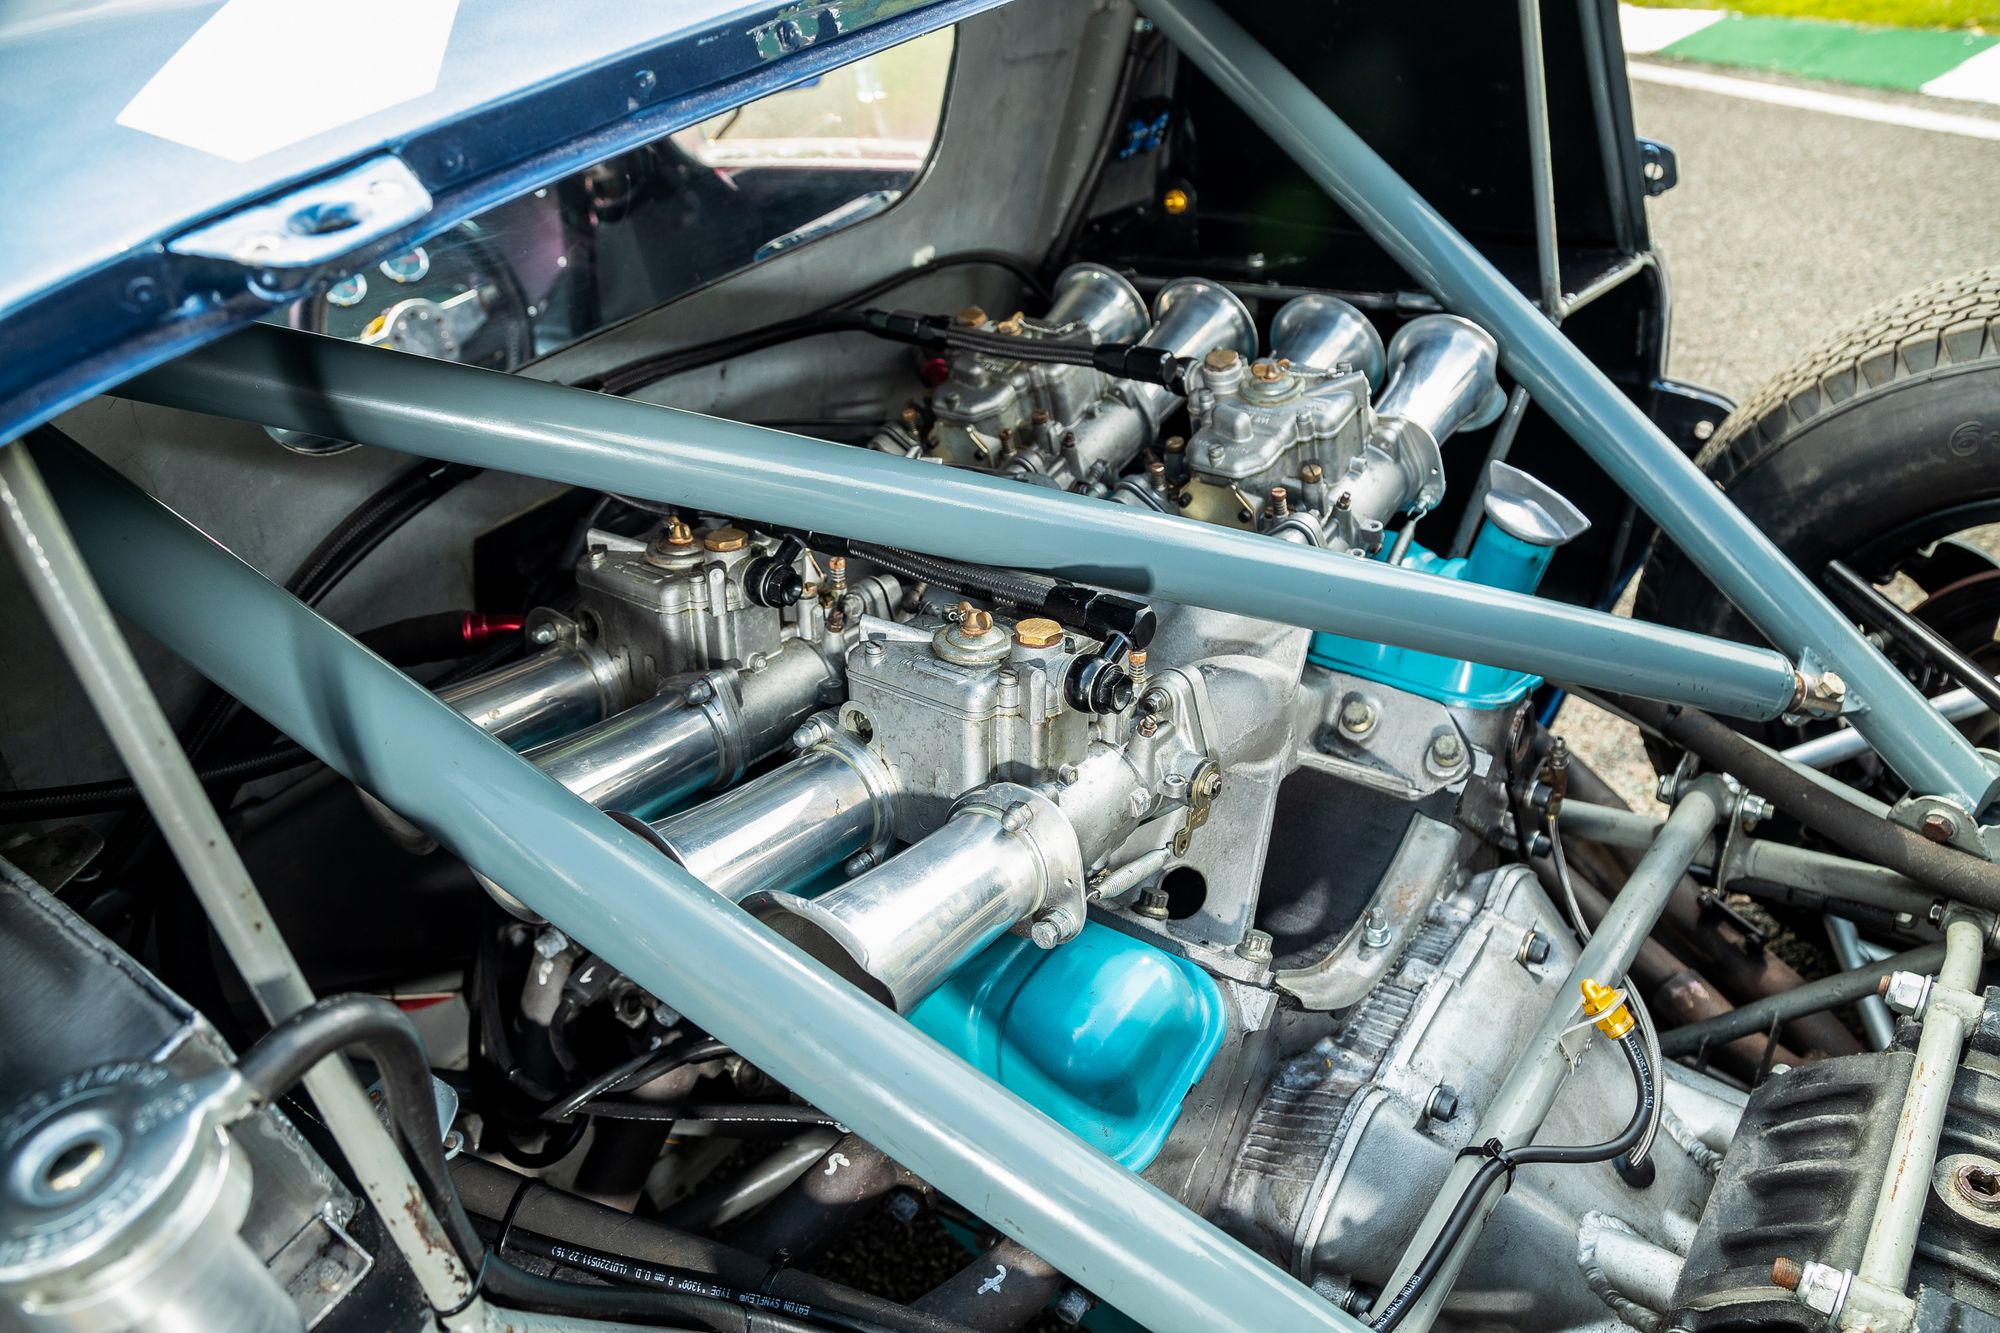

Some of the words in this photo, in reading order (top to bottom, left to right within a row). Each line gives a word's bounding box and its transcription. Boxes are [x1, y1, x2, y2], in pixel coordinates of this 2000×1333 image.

[710, 1285, 731, 1298] TYPE
[1400, 1274, 1421, 1298] EATON
[783, 1301, 811, 1316] EATON
